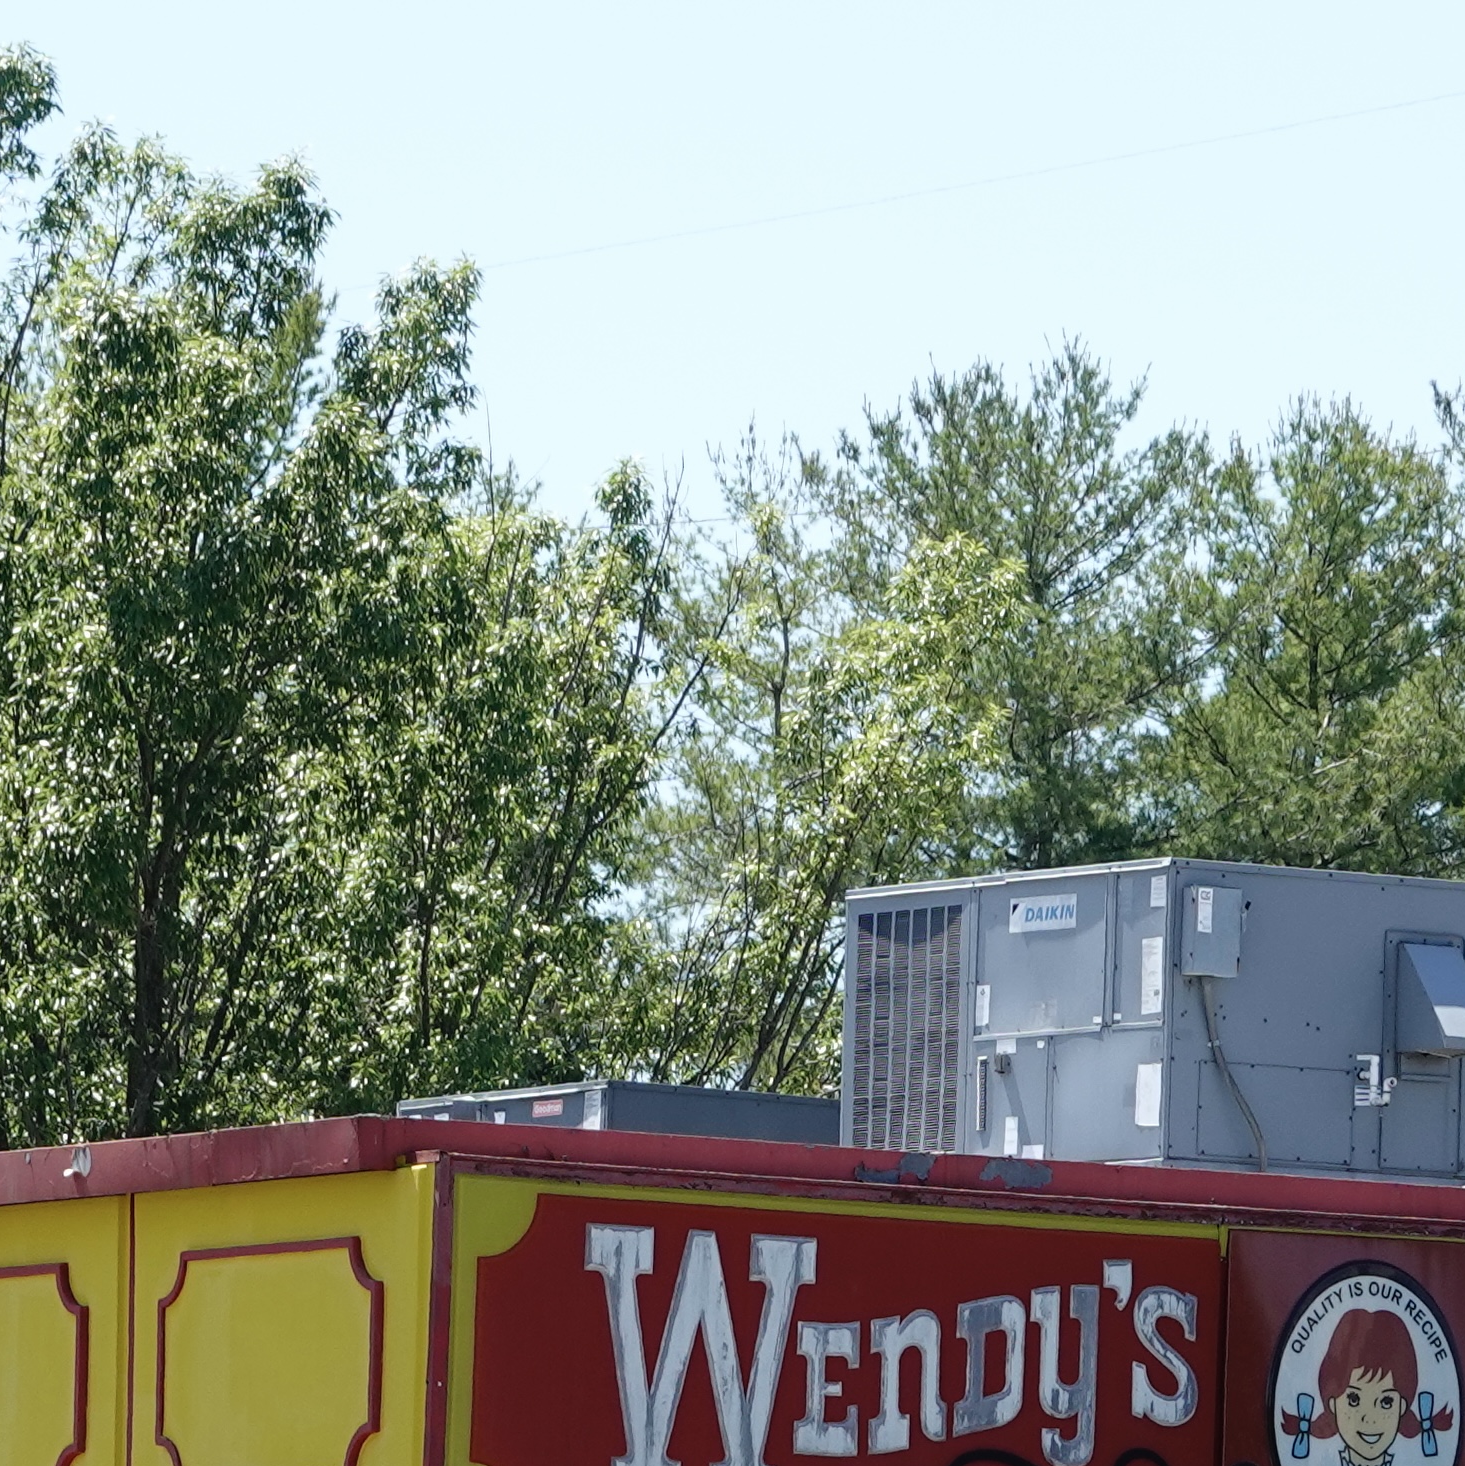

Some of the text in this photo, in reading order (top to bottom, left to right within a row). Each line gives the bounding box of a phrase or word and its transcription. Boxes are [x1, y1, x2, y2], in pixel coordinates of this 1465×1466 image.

[1025, 904, 1075, 922] DAIKIN
[1291, 1281, 1448, 1363] QUALITY IS OUR RECIPE
